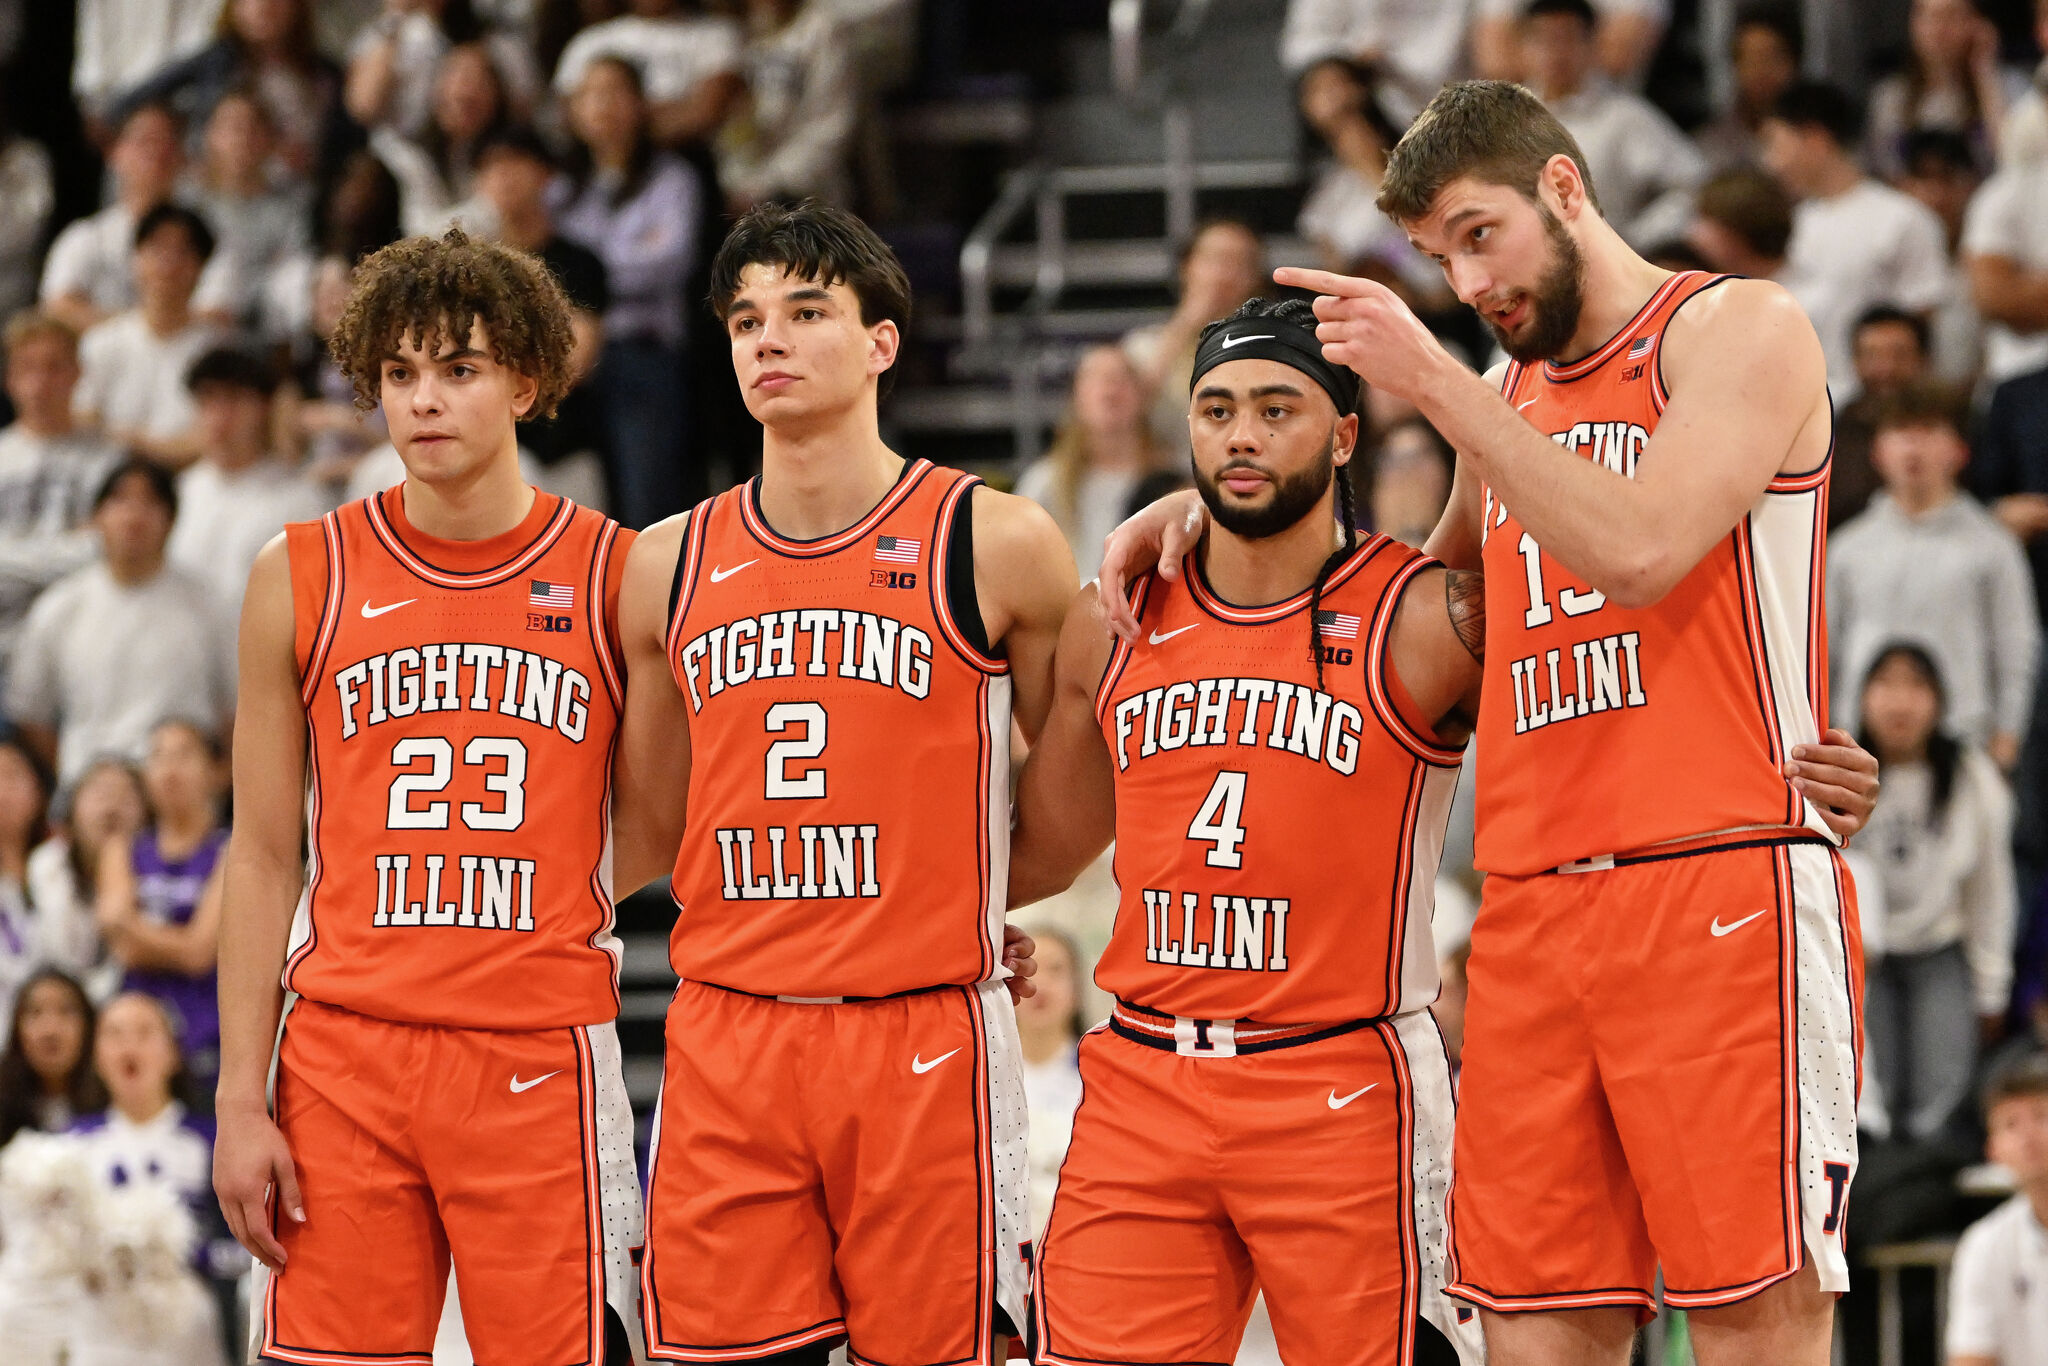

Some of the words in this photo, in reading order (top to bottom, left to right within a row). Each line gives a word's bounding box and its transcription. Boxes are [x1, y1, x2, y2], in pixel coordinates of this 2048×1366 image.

[334, 642, 592, 744] FIGHTING
[680, 608, 934, 717] FIGHTING
[1510, 631, 1648, 735] ILLINI
[763, 701, 828, 800] 2
[1115, 677, 1364, 776] FIGHTING
[385, 736, 528, 832] 23
[1186, 770, 1249, 870] 4
[372, 854, 536, 932] ILLINI
[715, 823, 881, 901] ILLINI
[1142, 889, 1290, 972] ILLINI
[1823, 1160, 1849, 1235] I
